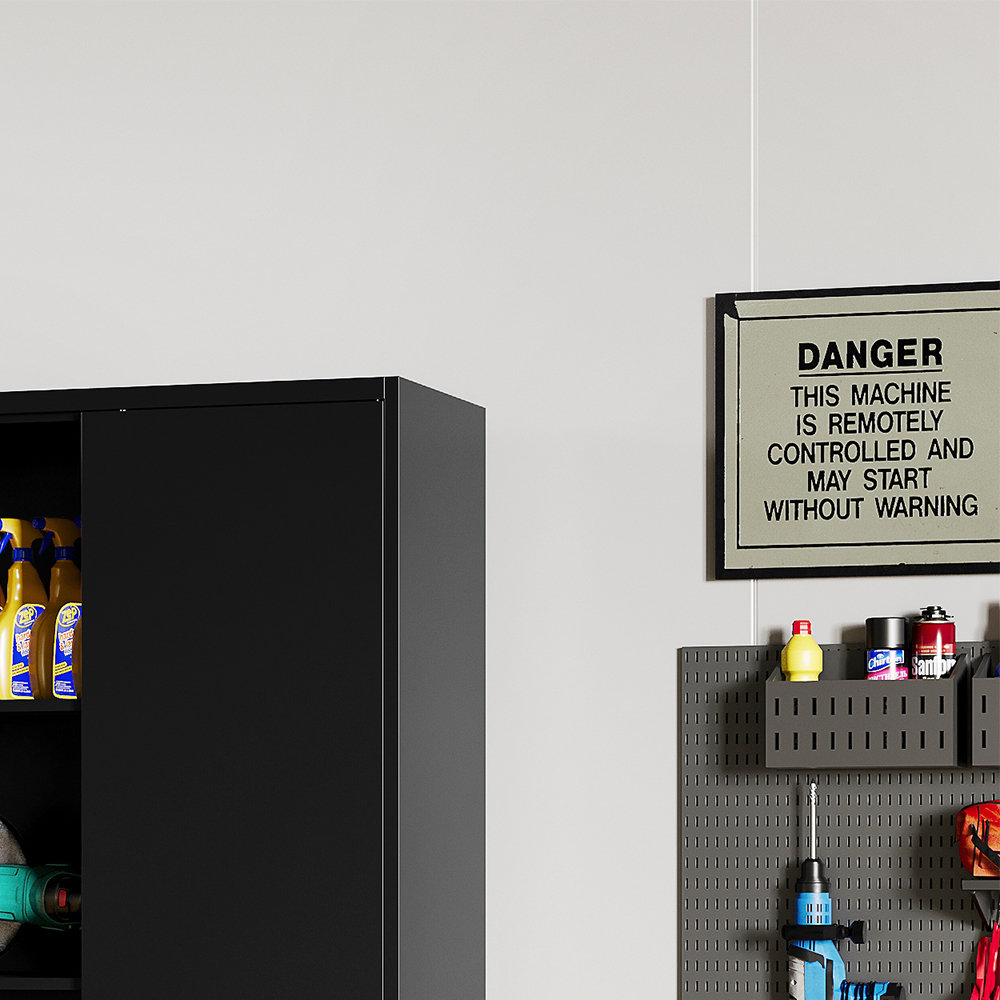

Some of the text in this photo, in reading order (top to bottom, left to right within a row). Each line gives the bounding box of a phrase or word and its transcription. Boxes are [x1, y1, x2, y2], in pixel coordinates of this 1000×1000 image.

[798, 337, 943, 371] DANGER
[790, 381, 951, 408] THIS MACHINE
[796, 410, 944, 436] IS REMOTELY
[767, 437, 975, 465] CONTROLLED AND
[807, 467, 933, 492] MAY START
[764, 494, 979, 522] WITHOUT WARNING
[868, 656, 902, 670] Chirtn
